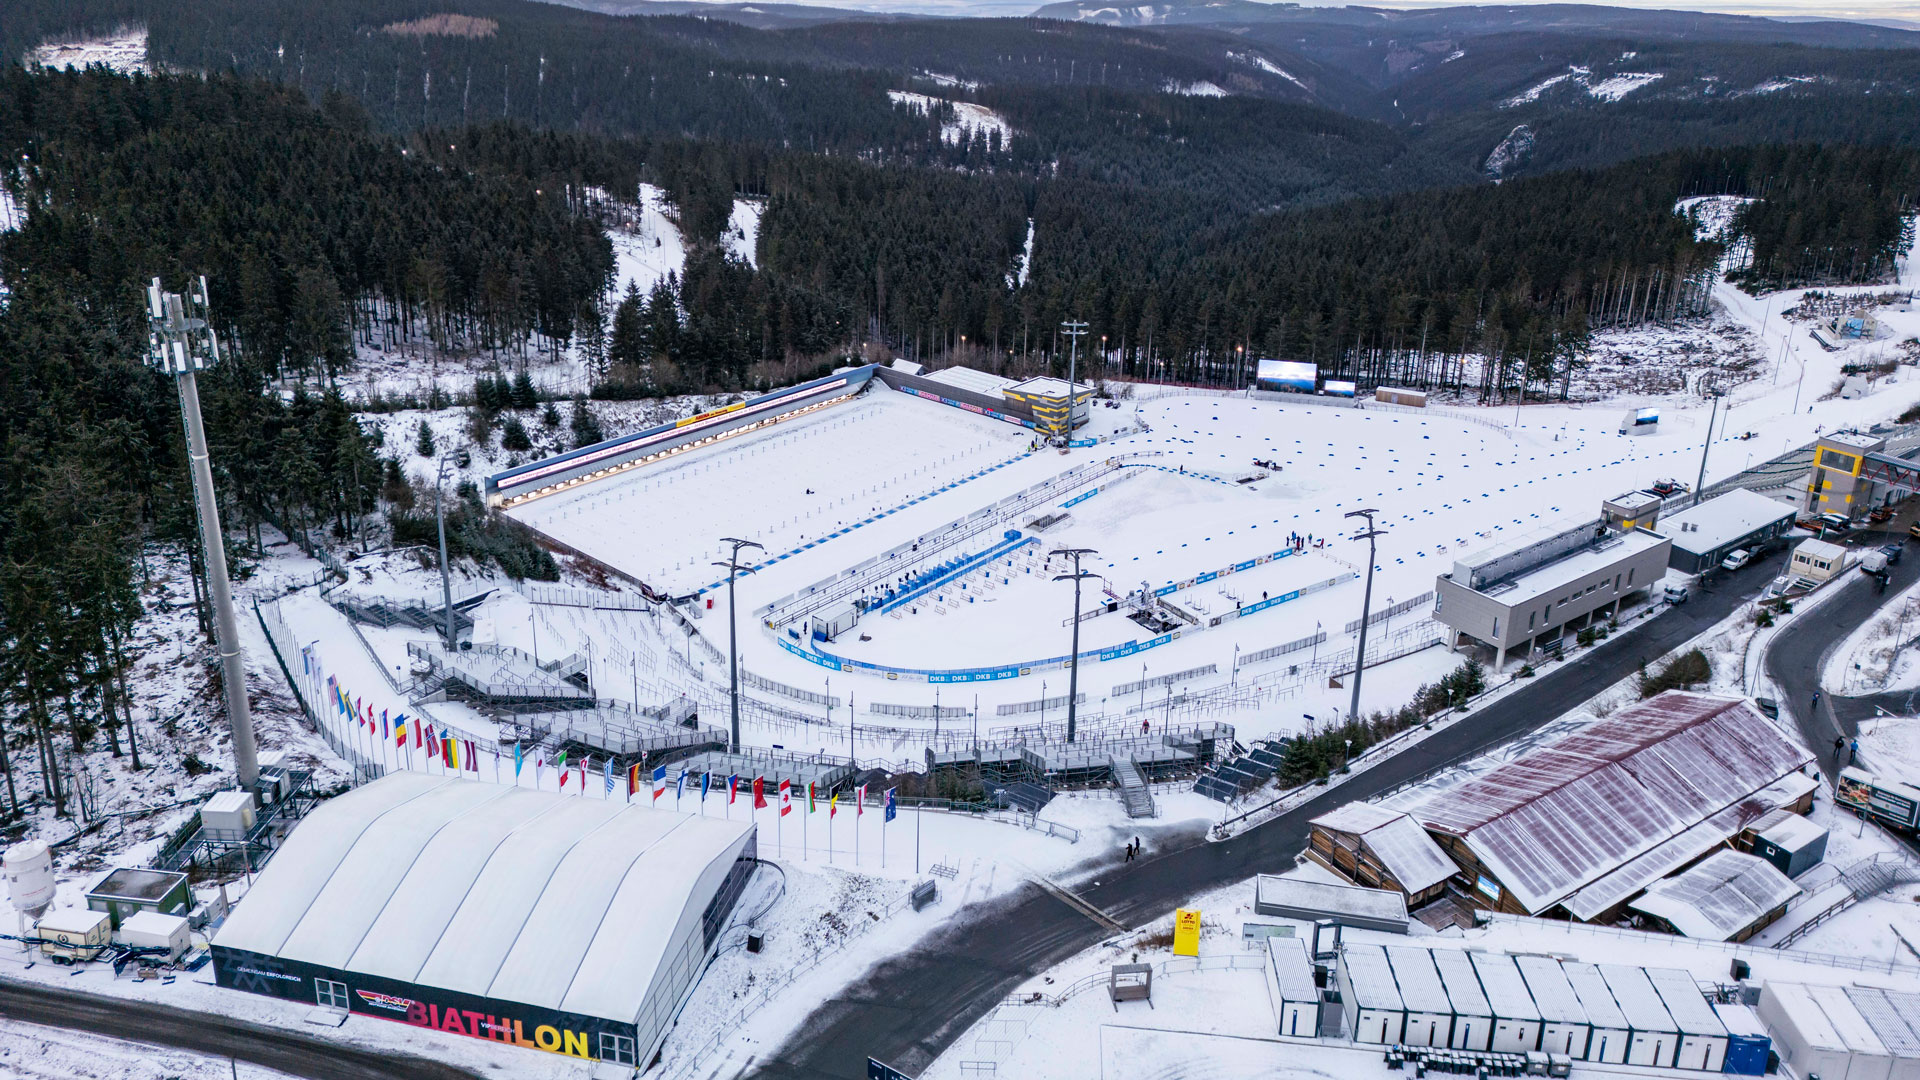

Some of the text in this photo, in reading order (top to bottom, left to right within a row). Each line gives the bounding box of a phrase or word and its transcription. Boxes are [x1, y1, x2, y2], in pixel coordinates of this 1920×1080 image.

[1101, 636, 1167, 660] DKB DKB DKB DKB
[822, 660, 835, 669] DKB
[266, 971, 302, 983] ERFOLGREICH
[406, 1001, 590, 1061] BIATHLON
